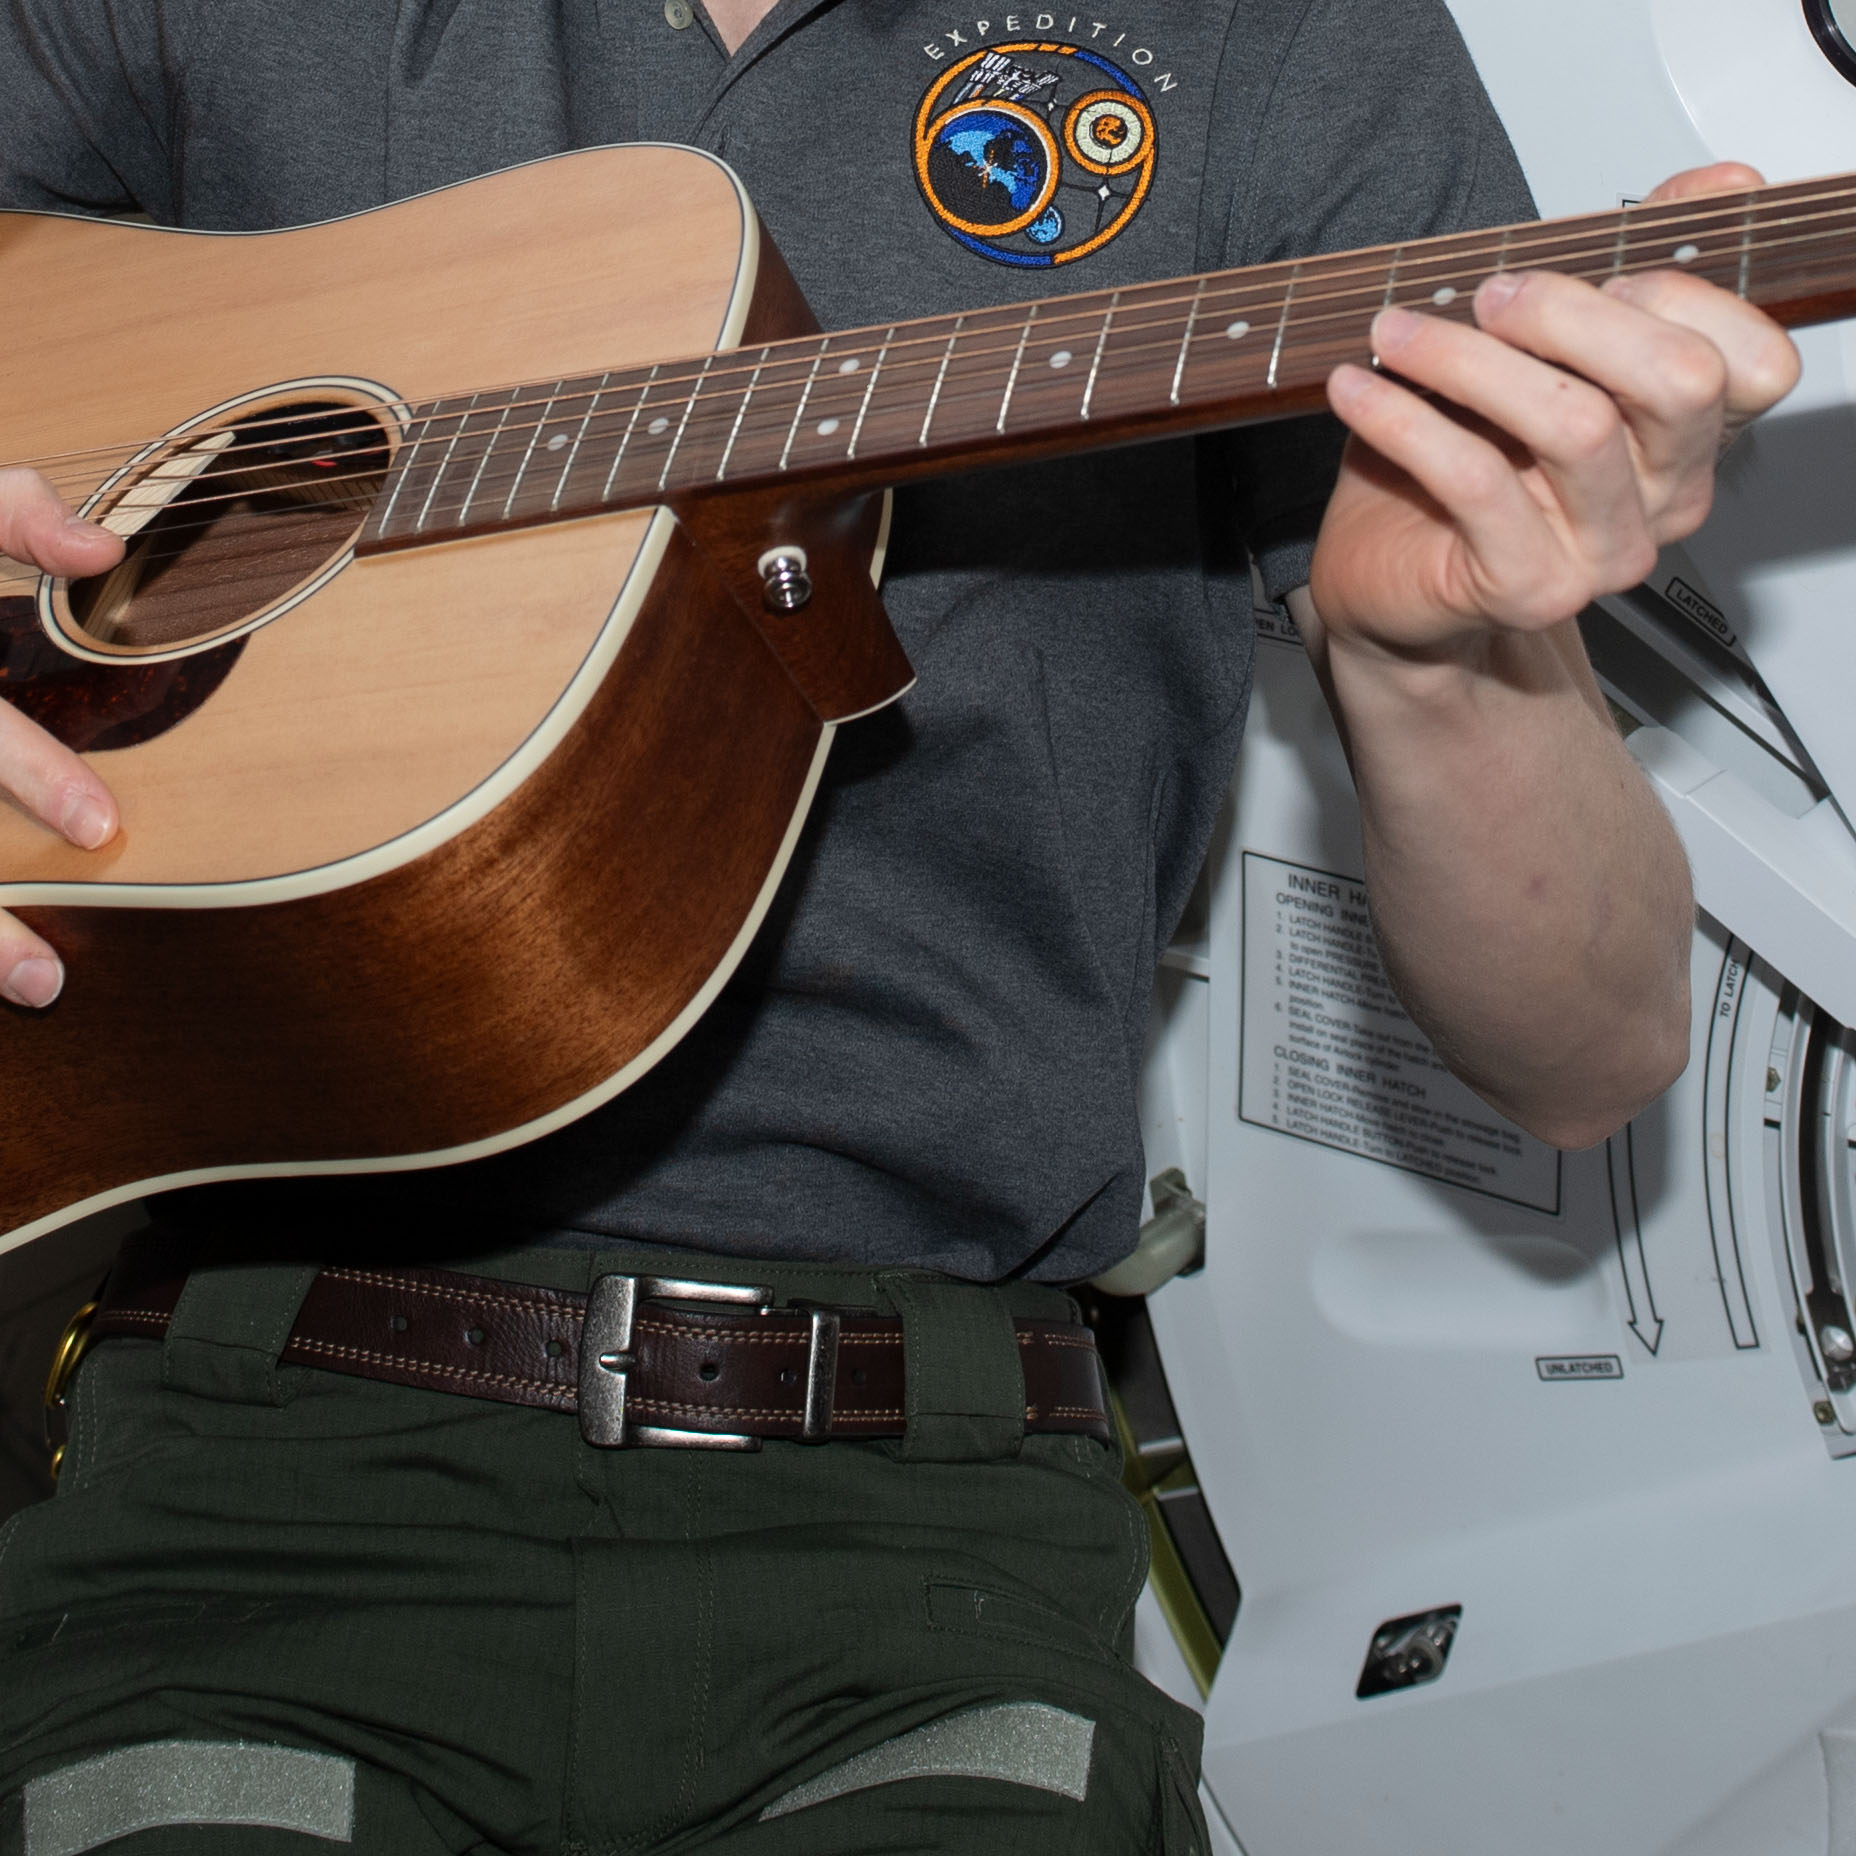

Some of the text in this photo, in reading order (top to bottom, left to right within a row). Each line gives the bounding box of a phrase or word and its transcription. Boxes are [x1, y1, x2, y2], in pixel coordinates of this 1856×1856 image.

[924, 13, 1178, 93] EXPEDITION
[1676, 587, 1728, 635] LATCHED
[1288, 872, 1340, 901] INNER
[1276, 890, 1333, 918] OPENING
[1289, 912, 1361, 942] LATCH HANDLE
[1289, 926, 1320, 944] LATCH
[1288, 978, 1319, 997] INNER
[1289, 965, 1320, 984] LATCH
[1719, 958, 1740, 1018] TO LATCH
[1274, 1043, 1426, 1099] CLOSING INNER HATCH
[1287, 1078, 1314, 1095] OPEN
[1317, 1087, 1342, 1104] LOCK
[1287, 1091, 1317, 1110] INNER
[1286, 1105, 1317, 1124] LATCH
[1320, 1115, 1358, 1135] HANDLE
[1286, 1118, 1317, 1137] LATCH
[1546, 1361, 1613, 1375] UNLATCHED
